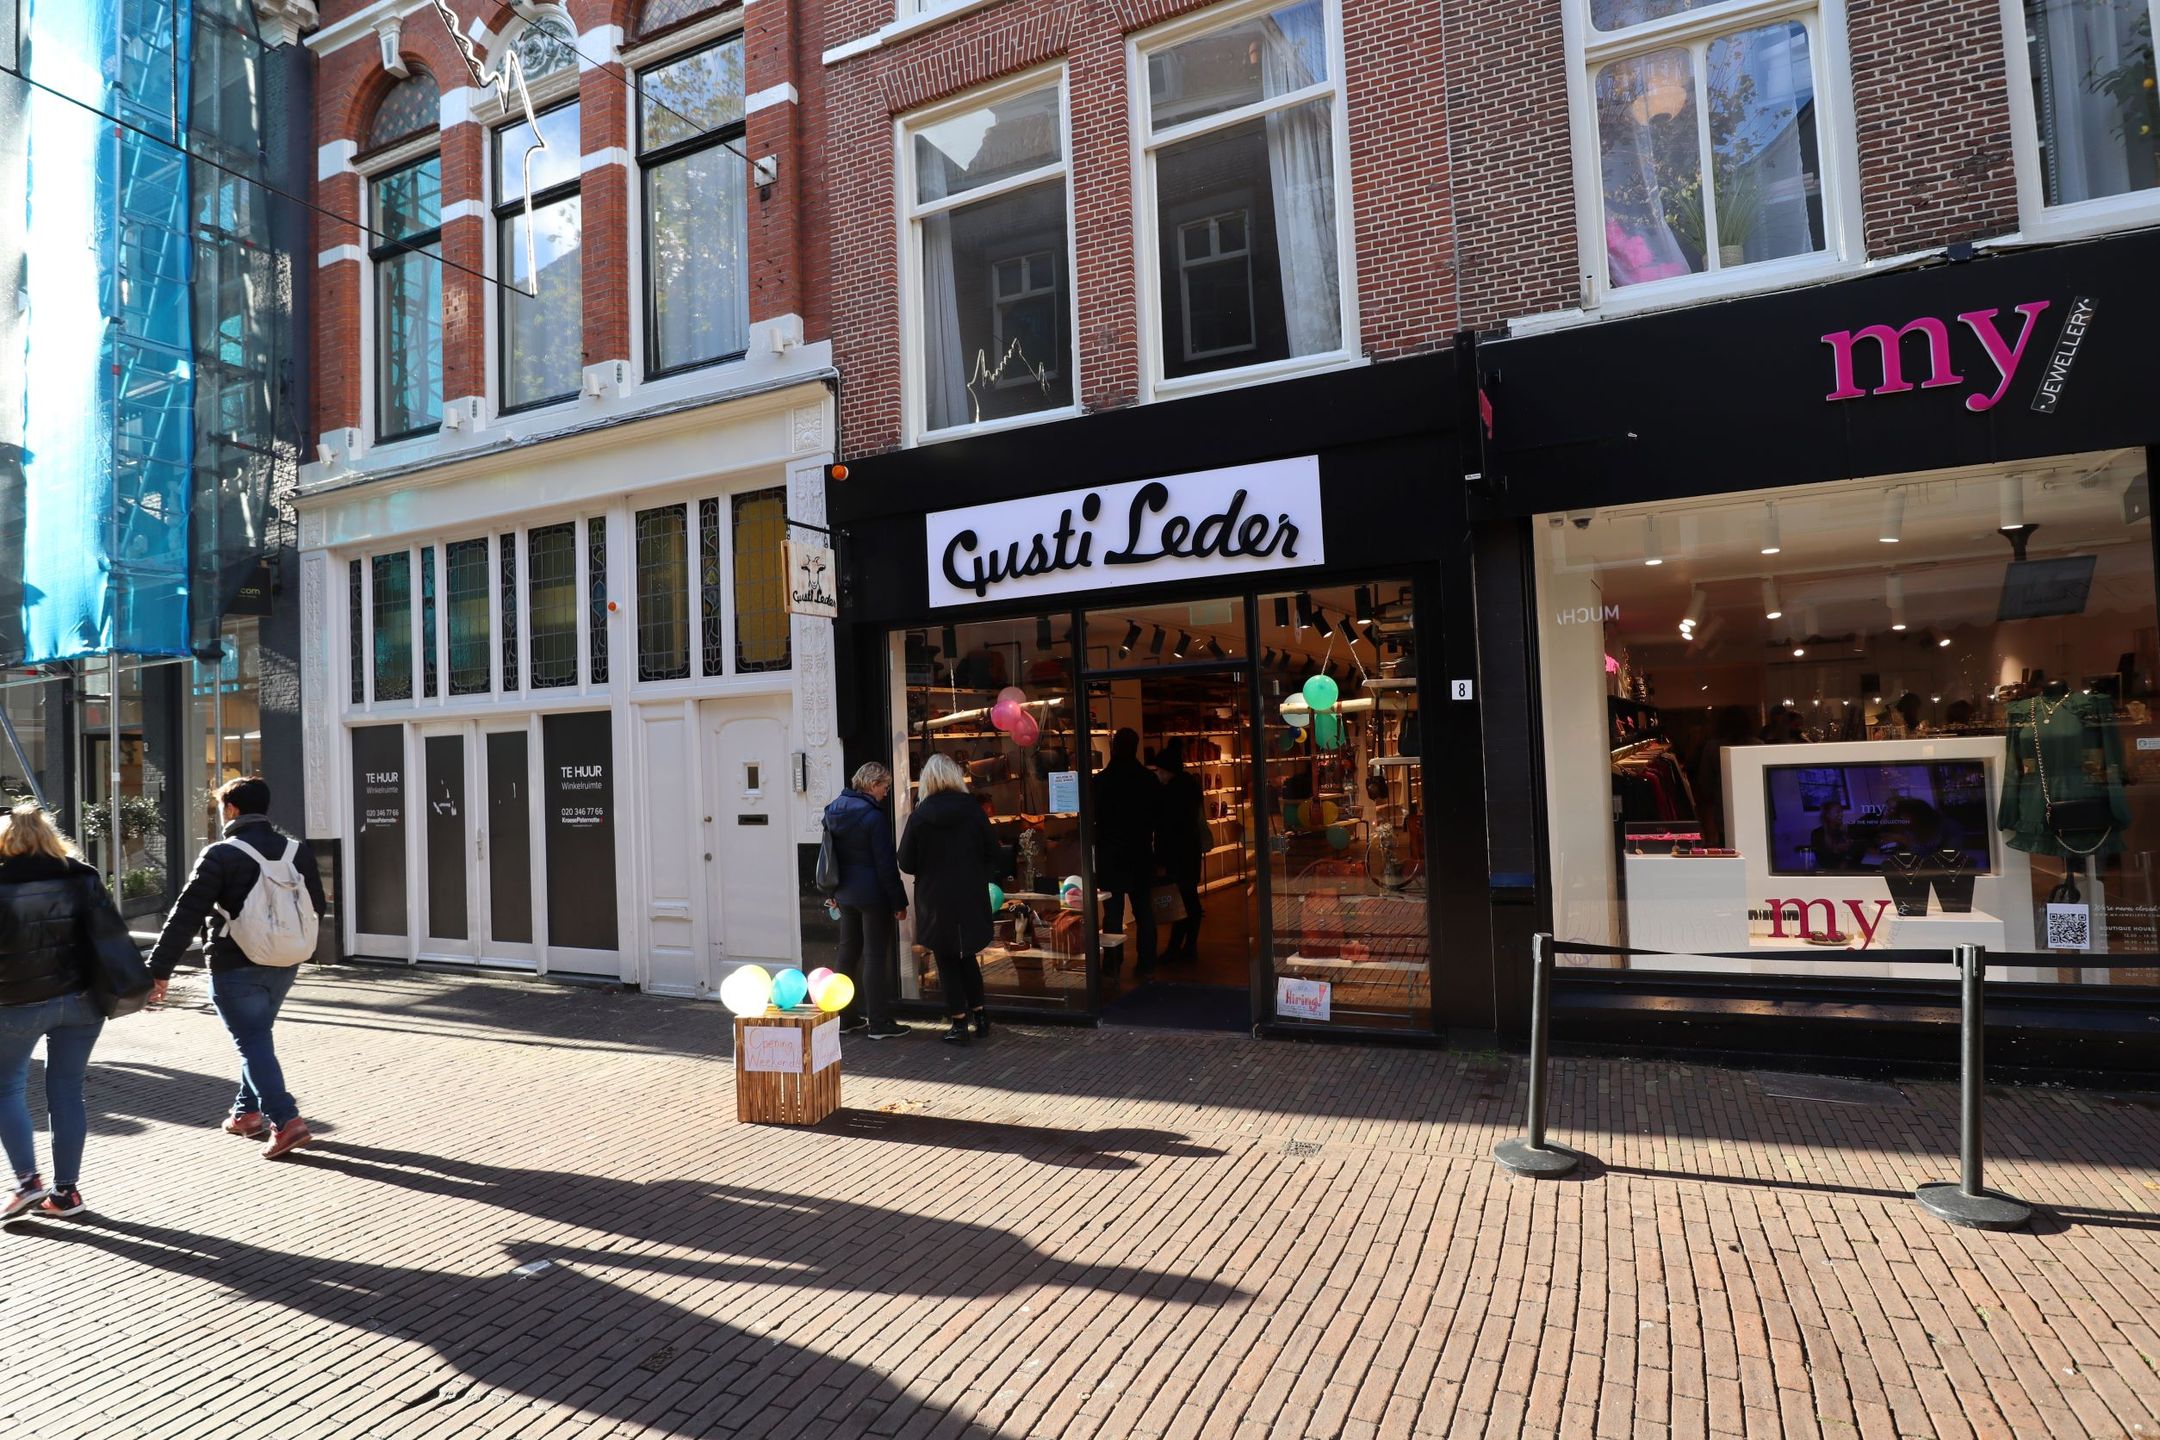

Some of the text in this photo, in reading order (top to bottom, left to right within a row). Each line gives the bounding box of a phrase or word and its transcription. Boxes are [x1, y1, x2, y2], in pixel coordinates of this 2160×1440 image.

[1821, 300, 2050, 412] my
[2041, 302, 2093, 404] JEWELLERY
[942, 482, 1300, 598] Gusti Leder
[814, 588, 838, 608] Leder
[1458, 682, 1466, 697] 8
[366, 772, 399, 783] TE HUUR
[561, 765, 602, 778] TE HUUR
[561, 781, 603, 790] Winkelruimte
[561, 808, 573, 816] 020
[574, 808, 586, 816] 346
[1861, 804, 1885, 817] my
[1765, 898, 1892, 951] my
[749, 1028, 793, 1055] Opening
